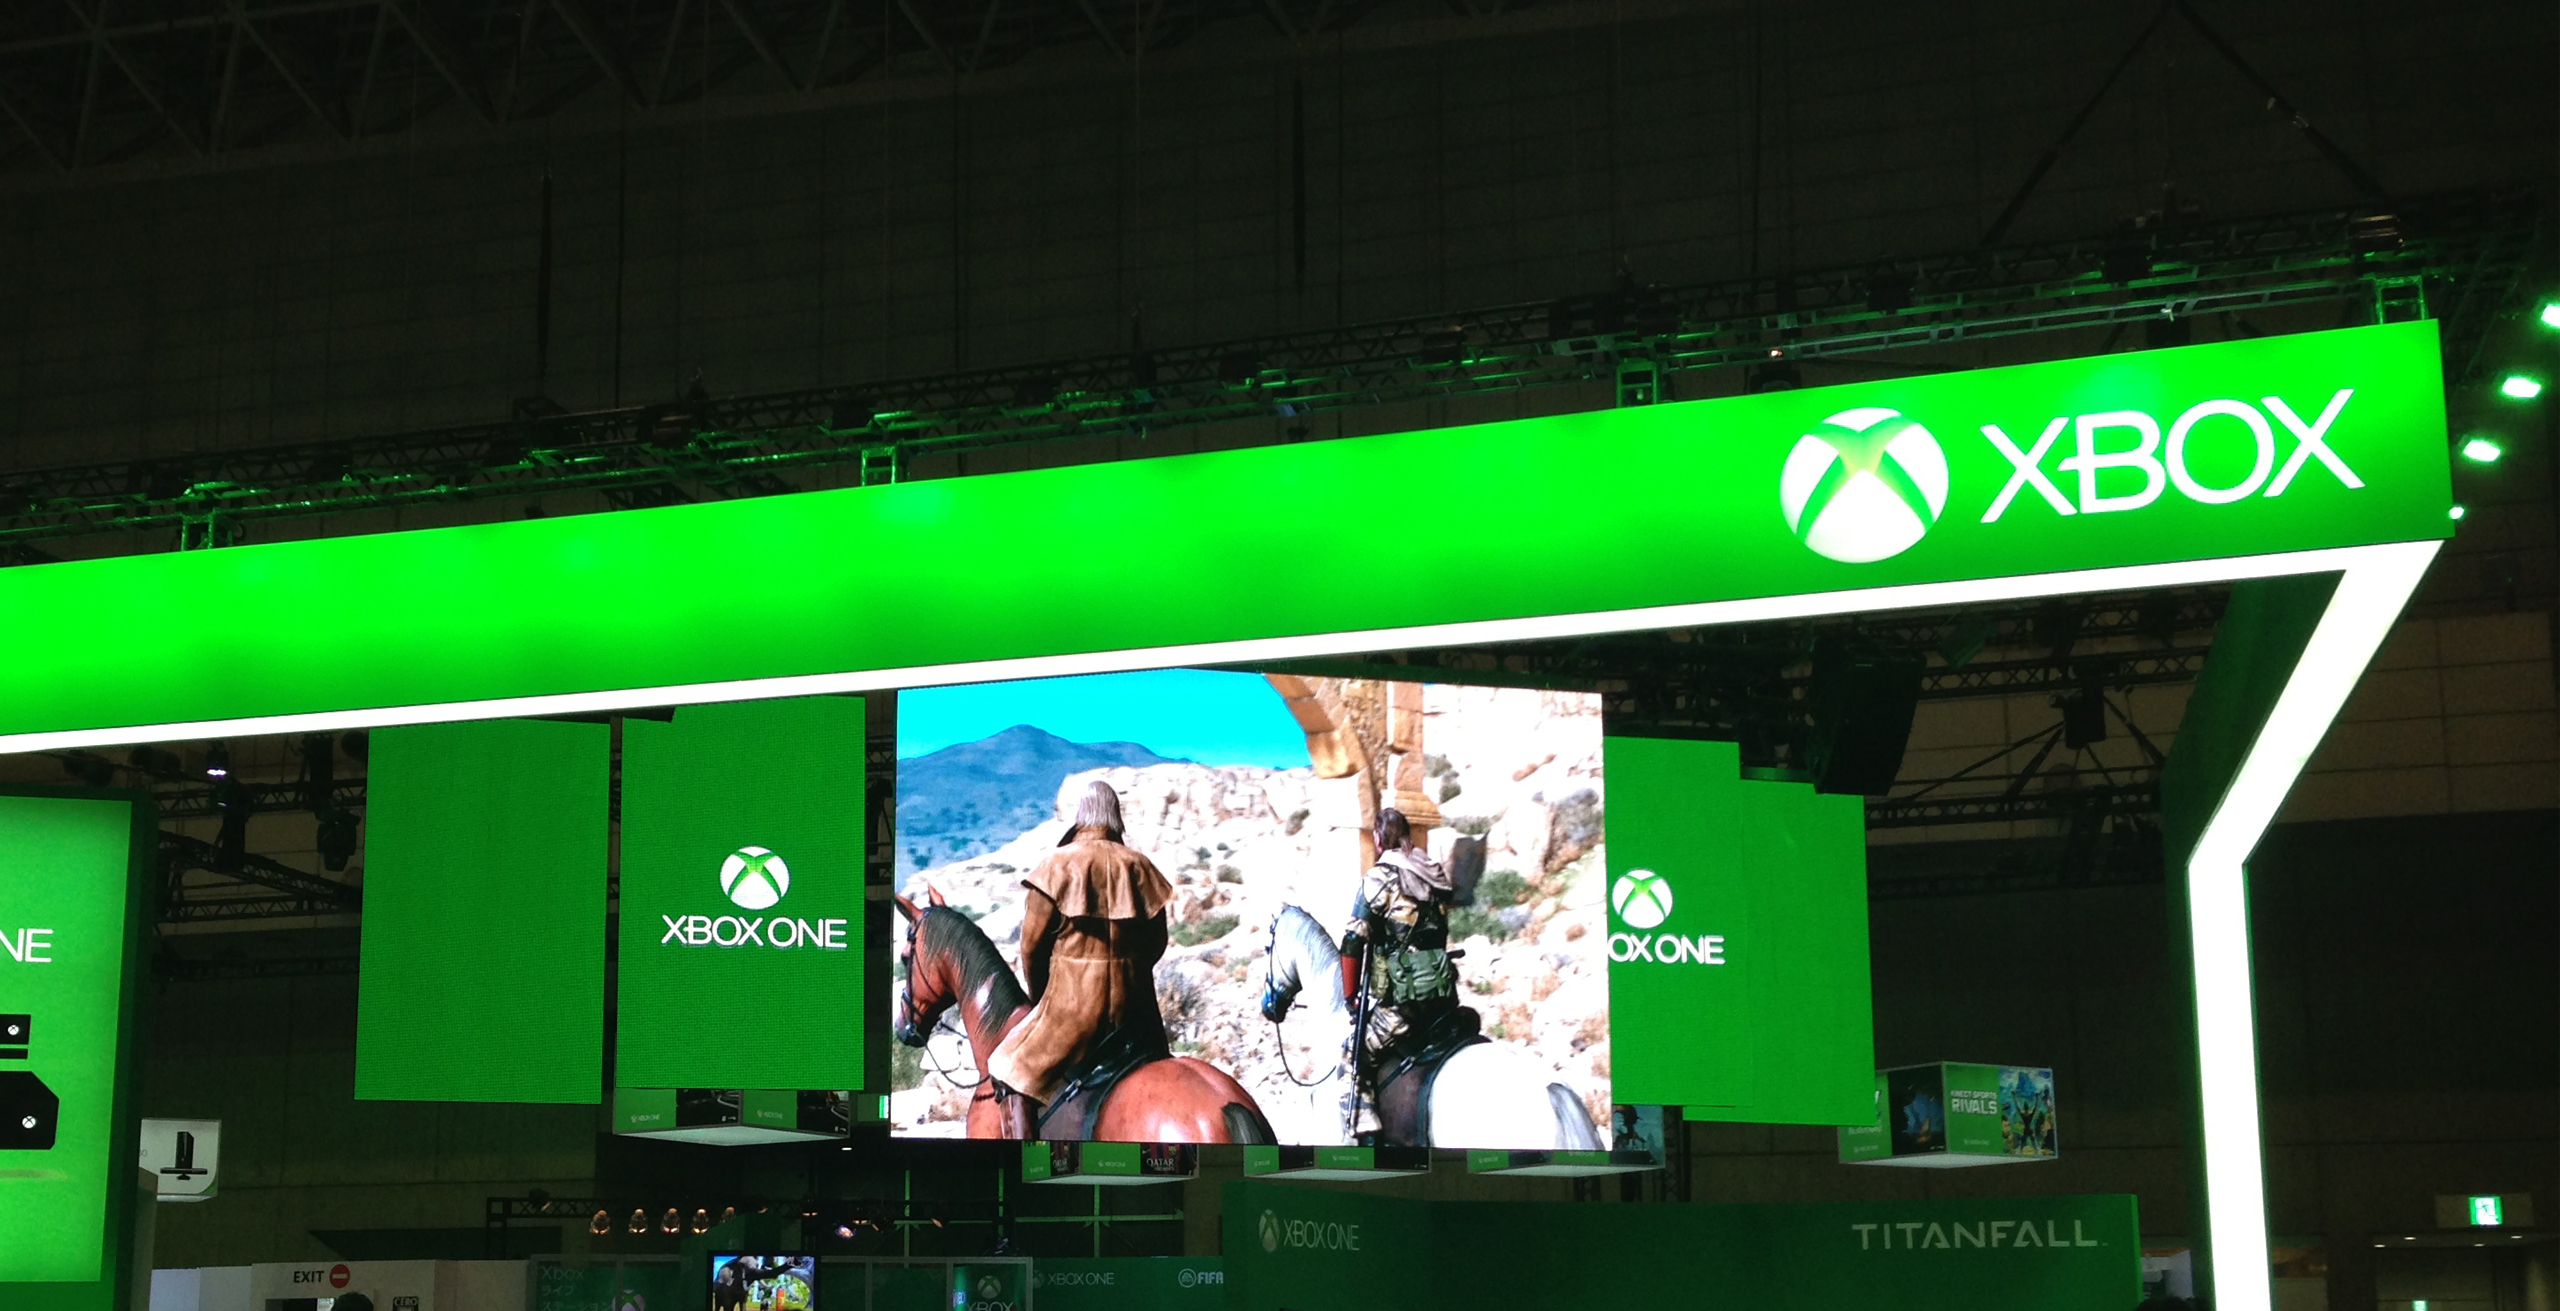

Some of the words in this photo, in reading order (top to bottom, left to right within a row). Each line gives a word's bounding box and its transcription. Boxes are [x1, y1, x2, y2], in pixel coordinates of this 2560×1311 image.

[1979, 388, 2366, 524] XBOX
[661, 914, 764, 948] XBOX
[767, 916, 848, 949] ONE
[1655, 934, 1727, 965] ONE
[1952, 1098, 1998, 1115] RIVALS
[1146, 1157, 1175, 1168] QATAR
[1283, 1218, 1326, 1249] XBOX
[1327, 1222, 1360, 1251] ONE
[1851, 1219, 2098, 1250] TITANFALL
[293, 1271, 325, 1283] EXIT
[1047, 1272, 1086, 1286] XBOX
[1085, 1272, 1115, 1286] ONE
[1197, 1271, 1224, 1285] FIFA
